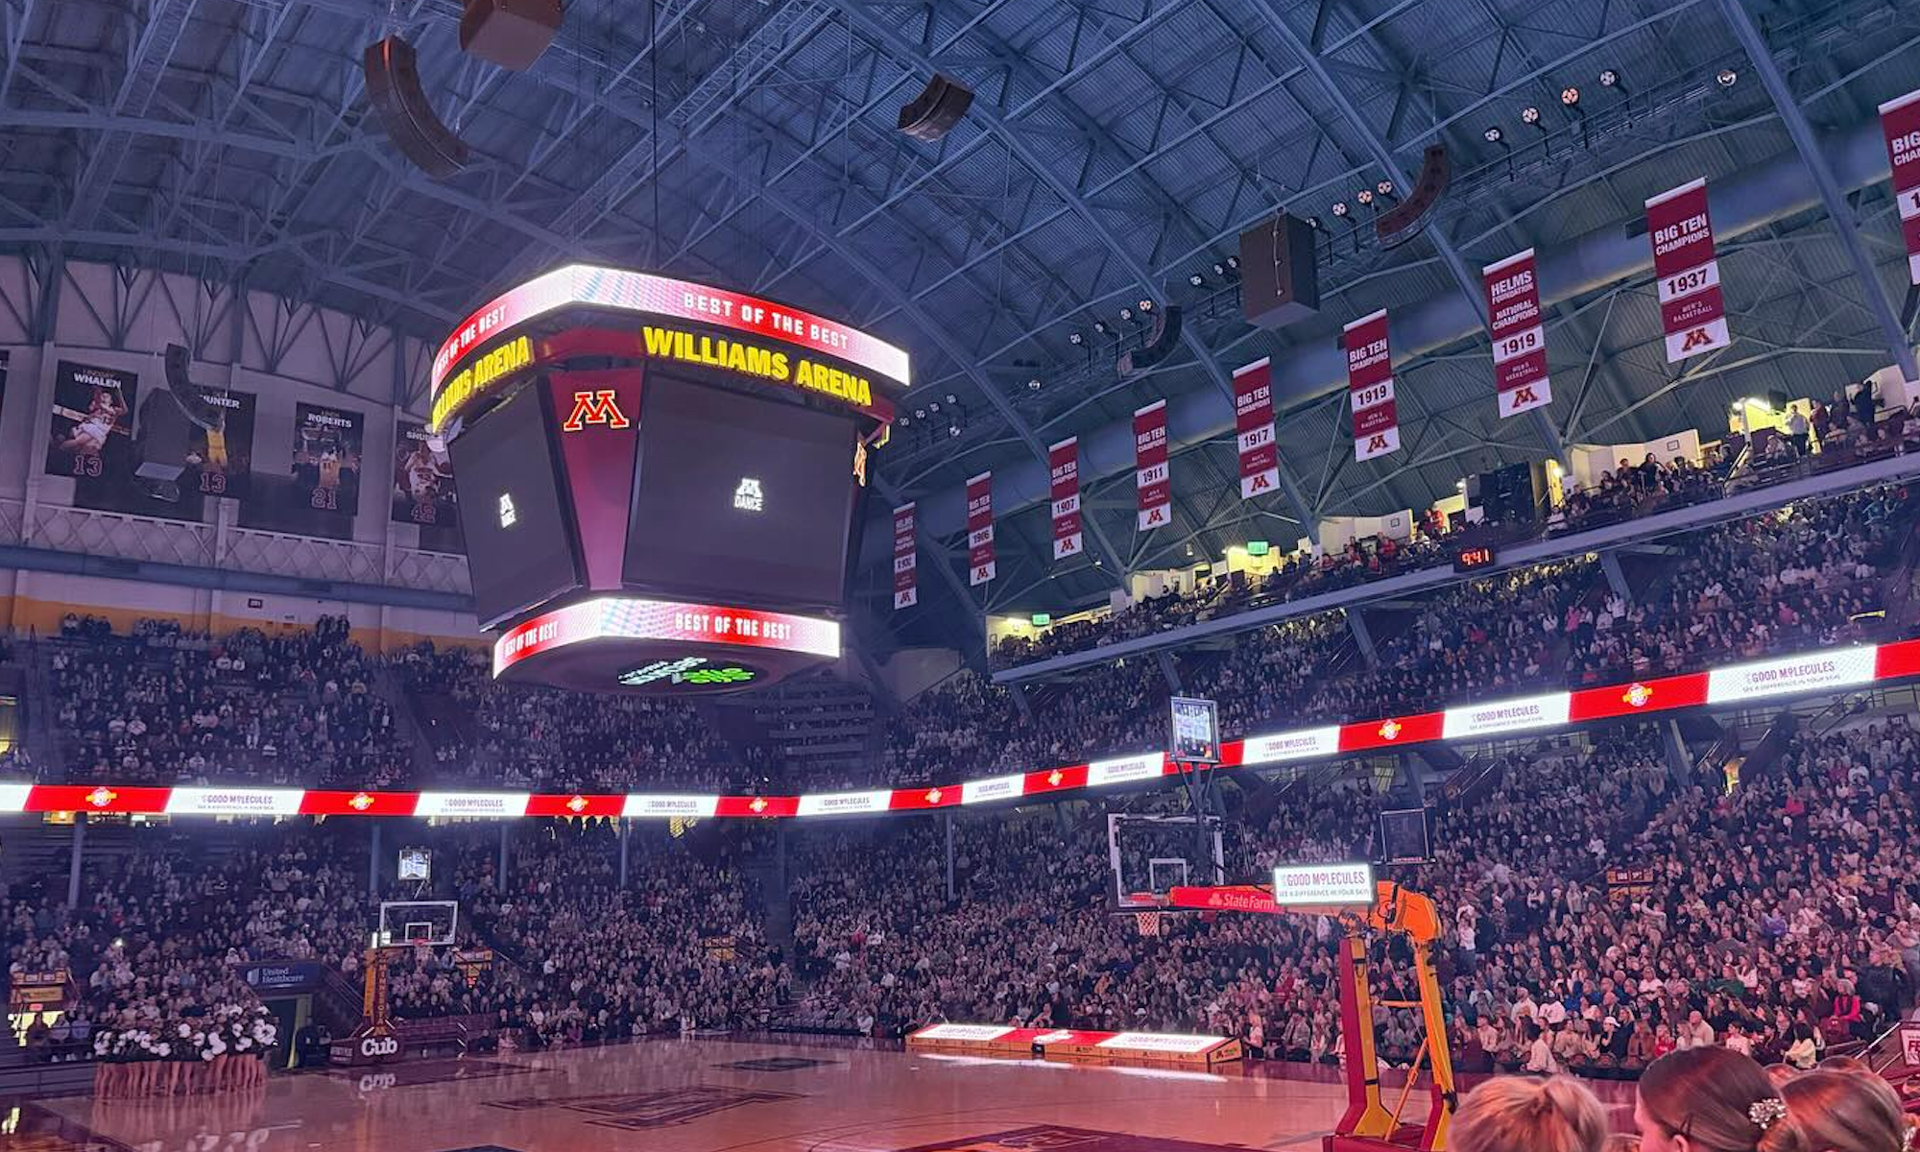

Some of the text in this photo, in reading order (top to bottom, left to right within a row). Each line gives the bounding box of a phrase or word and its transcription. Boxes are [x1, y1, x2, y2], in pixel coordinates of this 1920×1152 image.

[1655, 213, 1708, 245] BIG TEN
[1656, 227, 1710, 257] CHAMPIONS
[1491, 270, 1533, 297] HELMS
[1668, 268, 1708, 295] 1937
[479, 304, 506, 334] BEST
[1492, 306, 1539, 331] CHAMPIONS
[1496, 300, 1534, 320] NATIONAL
[684, 293, 848, 350] BEST OF THE BEST
[1350, 338, 1388, 363] BIG TEN
[1502, 333, 1536, 356] 1919
[1682, 327, 1713, 352] M
[474, 335, 532, 389] ARENA
[643, 326, 872, 406] WILLIAMS ARENA
[1350, 350, 1389, 372] CHAMPIONS
[74, 373, 121, 388] WHALEN
[1237, 385, 1270, 407] BIG TEN
[1358, 385, 1387, 405] 1919
[1512, 386, 1538, 409] M
[308, 413, 352, 428] ROBERTS
[563, 390, 629, 431] M
[1138, 426, 1166, 445] BIG TEN
[1244, 429, 1269, 448] 1917
[1367, 435, 1388, 453] M
[74, 455, 102, 476] 13
[1143, 467, 1163, 483] 1911
[200, 473, 226, 493] 13
[1251, 474, 1270, 492] M
[312, 487, 337, 509] 21
[734, 495, 763, 511] DANCE
[1462, 549, 1490, 566] 9:41
[675, 613, 791, 640] BEST OF THE BEST
[1752, 661, 1835, 683] GOOD MOLECULES
[1477, 711, 1497, 723] GOOD
[1287, 871, 1366, 886] GOOD MOLECULES
[262, 967, 289, 976] United
[361, 1037, 398, 1056] Cub
